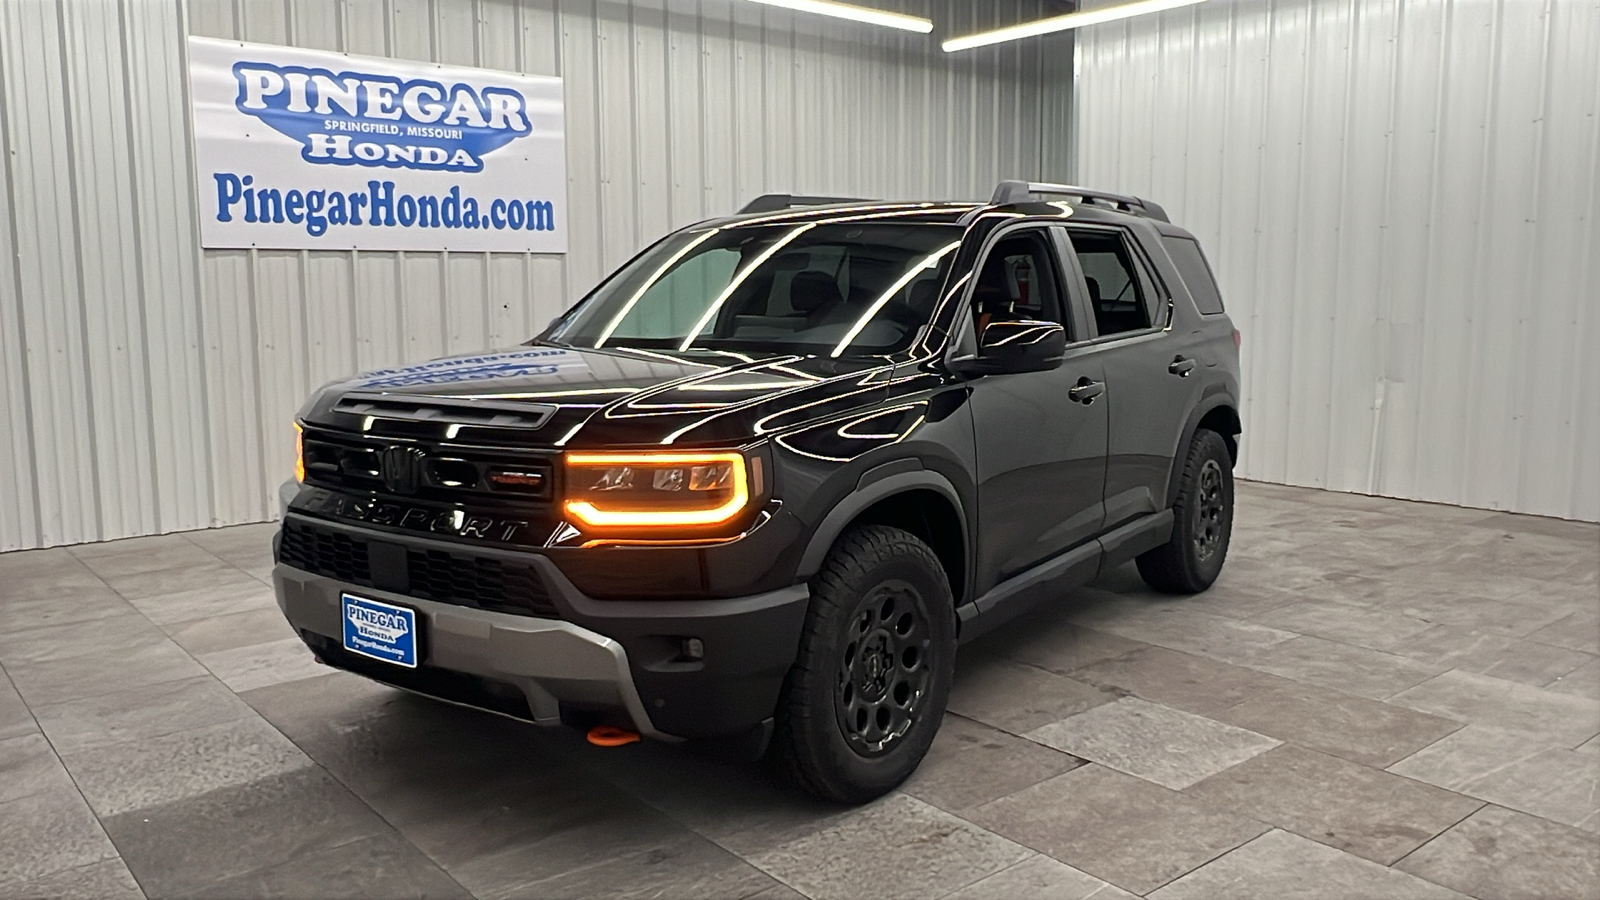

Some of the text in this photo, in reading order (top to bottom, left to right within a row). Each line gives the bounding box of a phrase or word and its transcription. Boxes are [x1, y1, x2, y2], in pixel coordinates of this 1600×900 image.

[239, 68, 528, 131] PINEGAR
[324, 119, 463, 140] SPRINGFIELD, MISSOURI
[307, 133, 478, 167] HONDA
[213, 172, 555, 237] PinegarHonda.com
[348, 606, 407, 631] PINEGAR
[360, 626, 395, 642] HONDA
